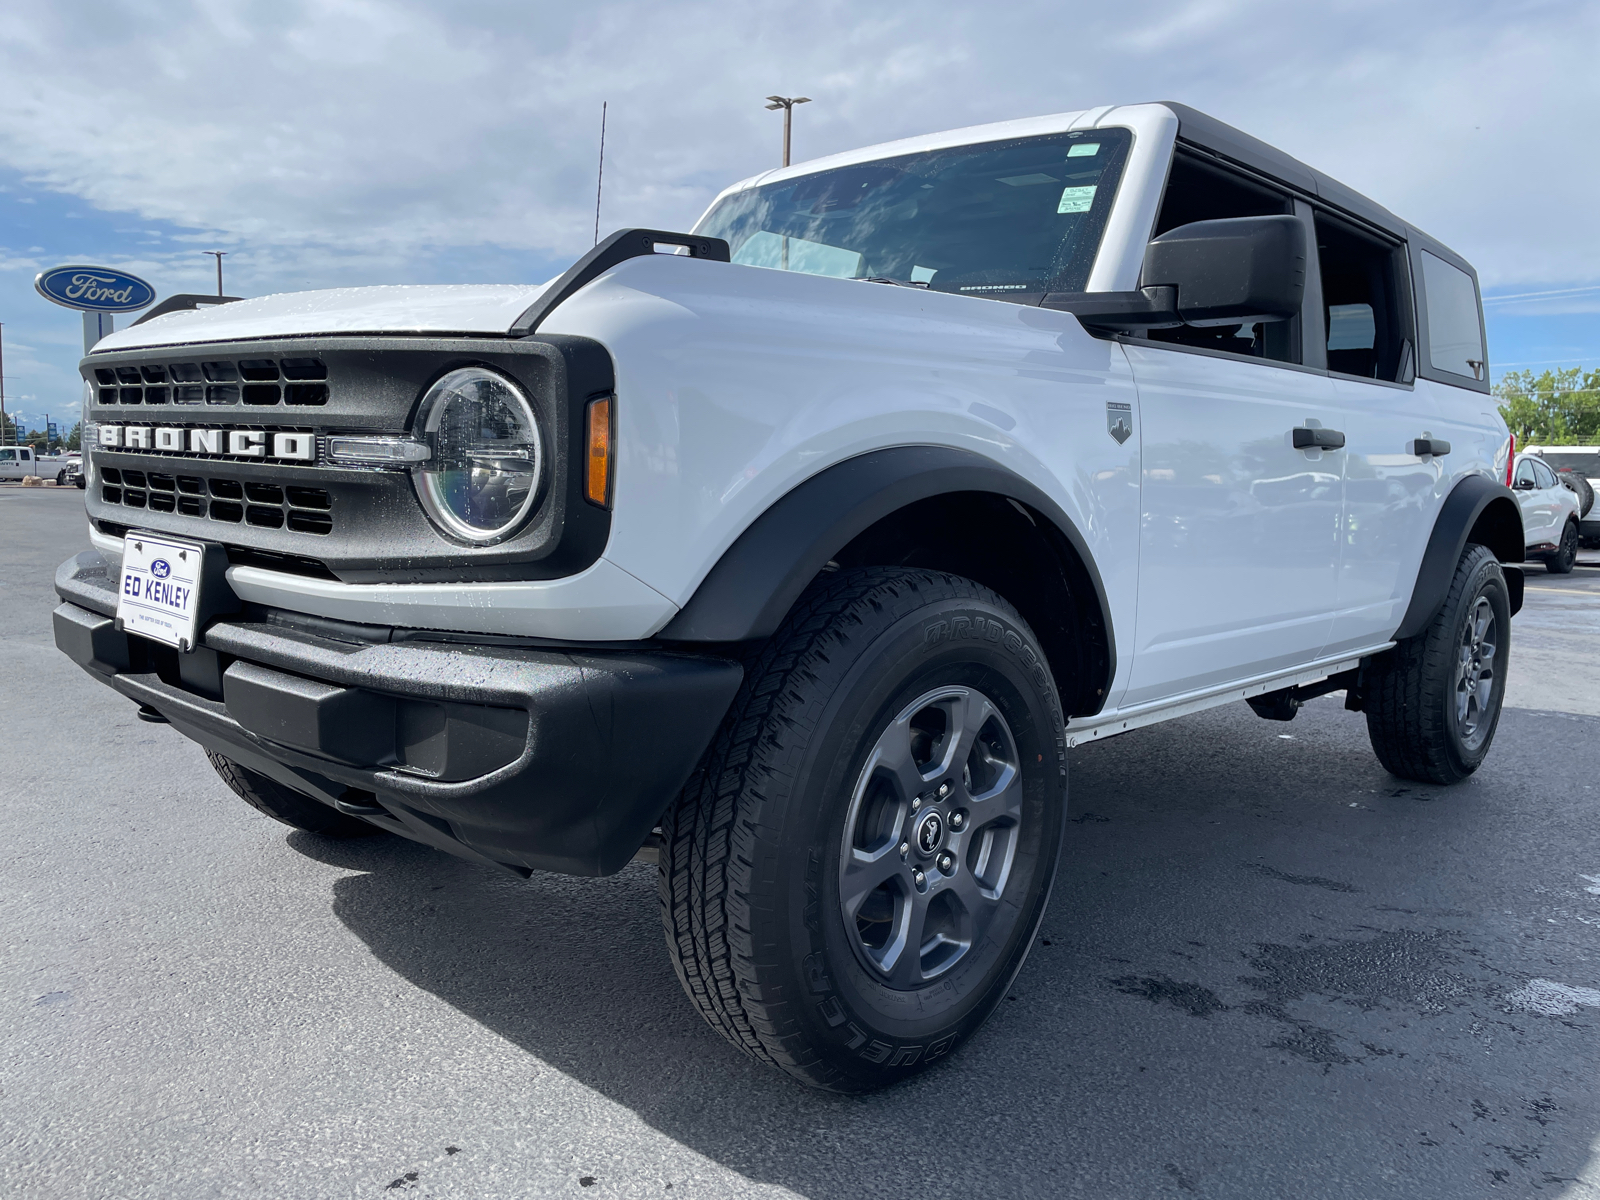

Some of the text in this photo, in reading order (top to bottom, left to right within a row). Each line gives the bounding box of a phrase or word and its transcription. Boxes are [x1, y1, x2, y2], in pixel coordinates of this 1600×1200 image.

[65, 273, 133, 303] Ford
[100, 425, 316, 461] BRONCO
[153, 560, 169, 577] Ford
[124, 574, 190, 610] ED KENLEY
[802, 951, 957, 1067] DUELER
